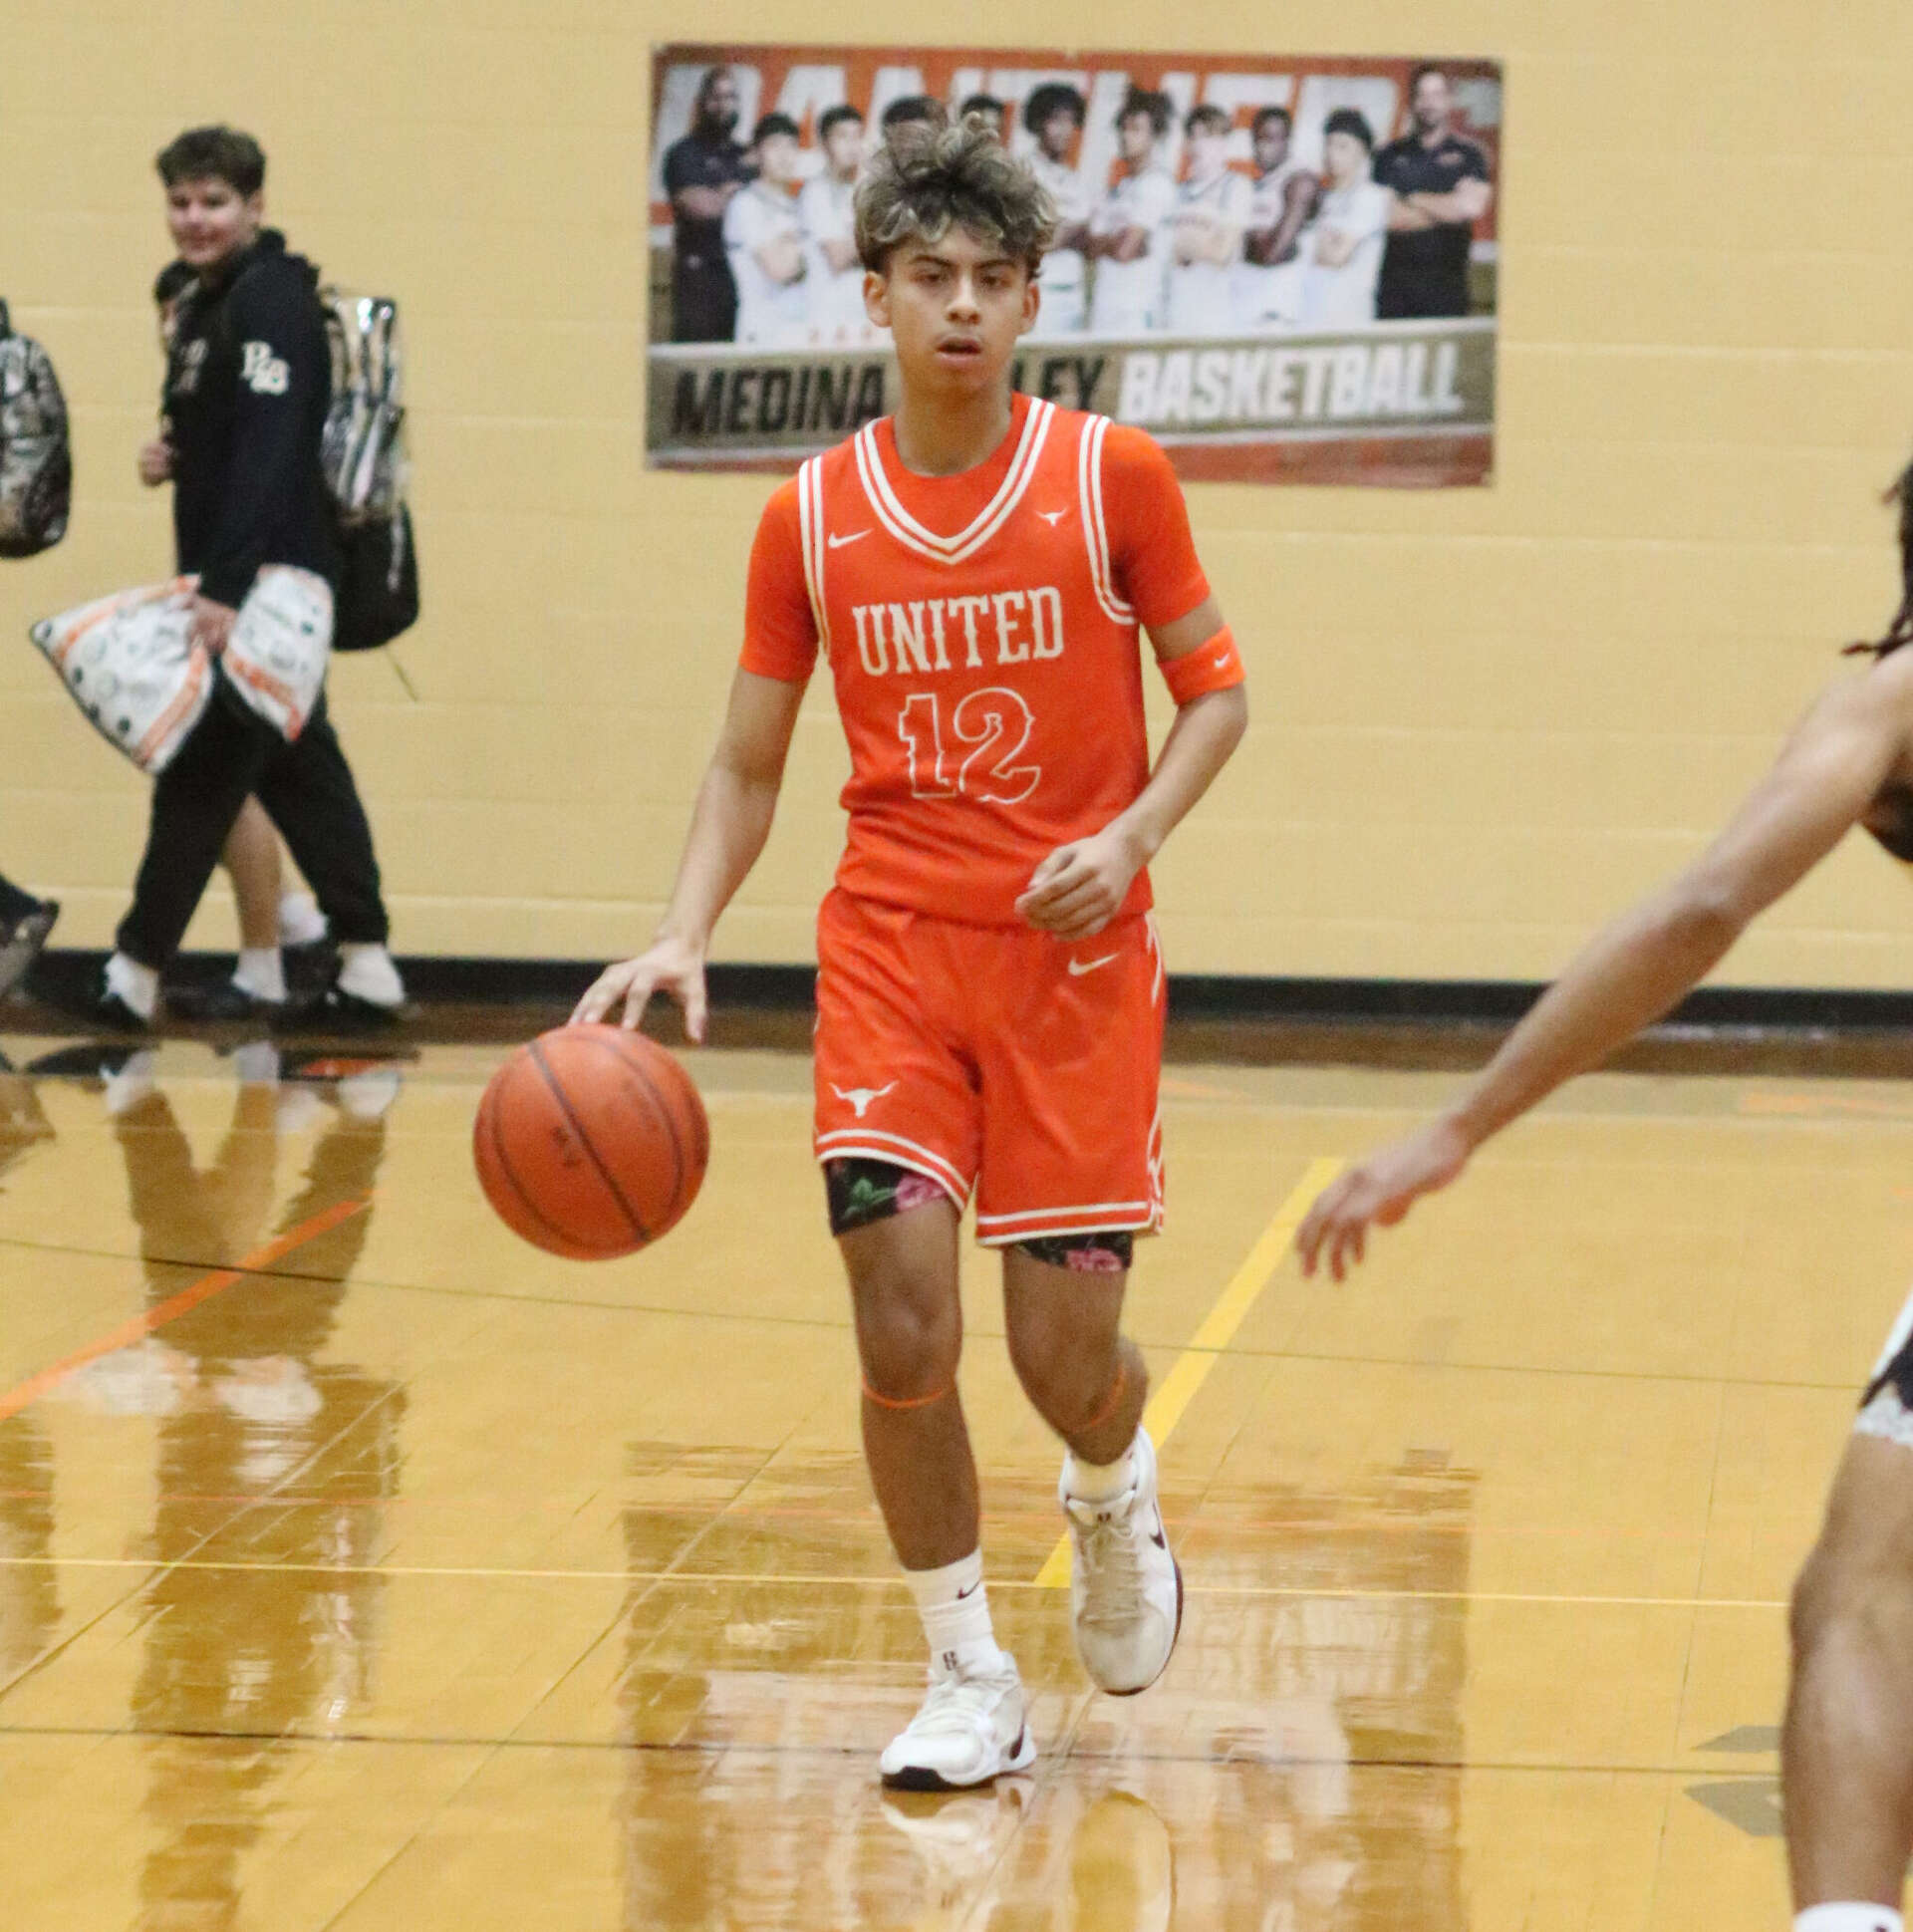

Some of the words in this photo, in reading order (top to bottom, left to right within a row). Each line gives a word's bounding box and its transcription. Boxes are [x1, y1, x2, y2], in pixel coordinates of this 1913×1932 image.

[672, 364, 885, 435] MEDINA
[1117, 342, 1464, 423] BASKETBALL
[852, 586, 1065, 677] UNITED
[899, 687, 1042, 805] 12
